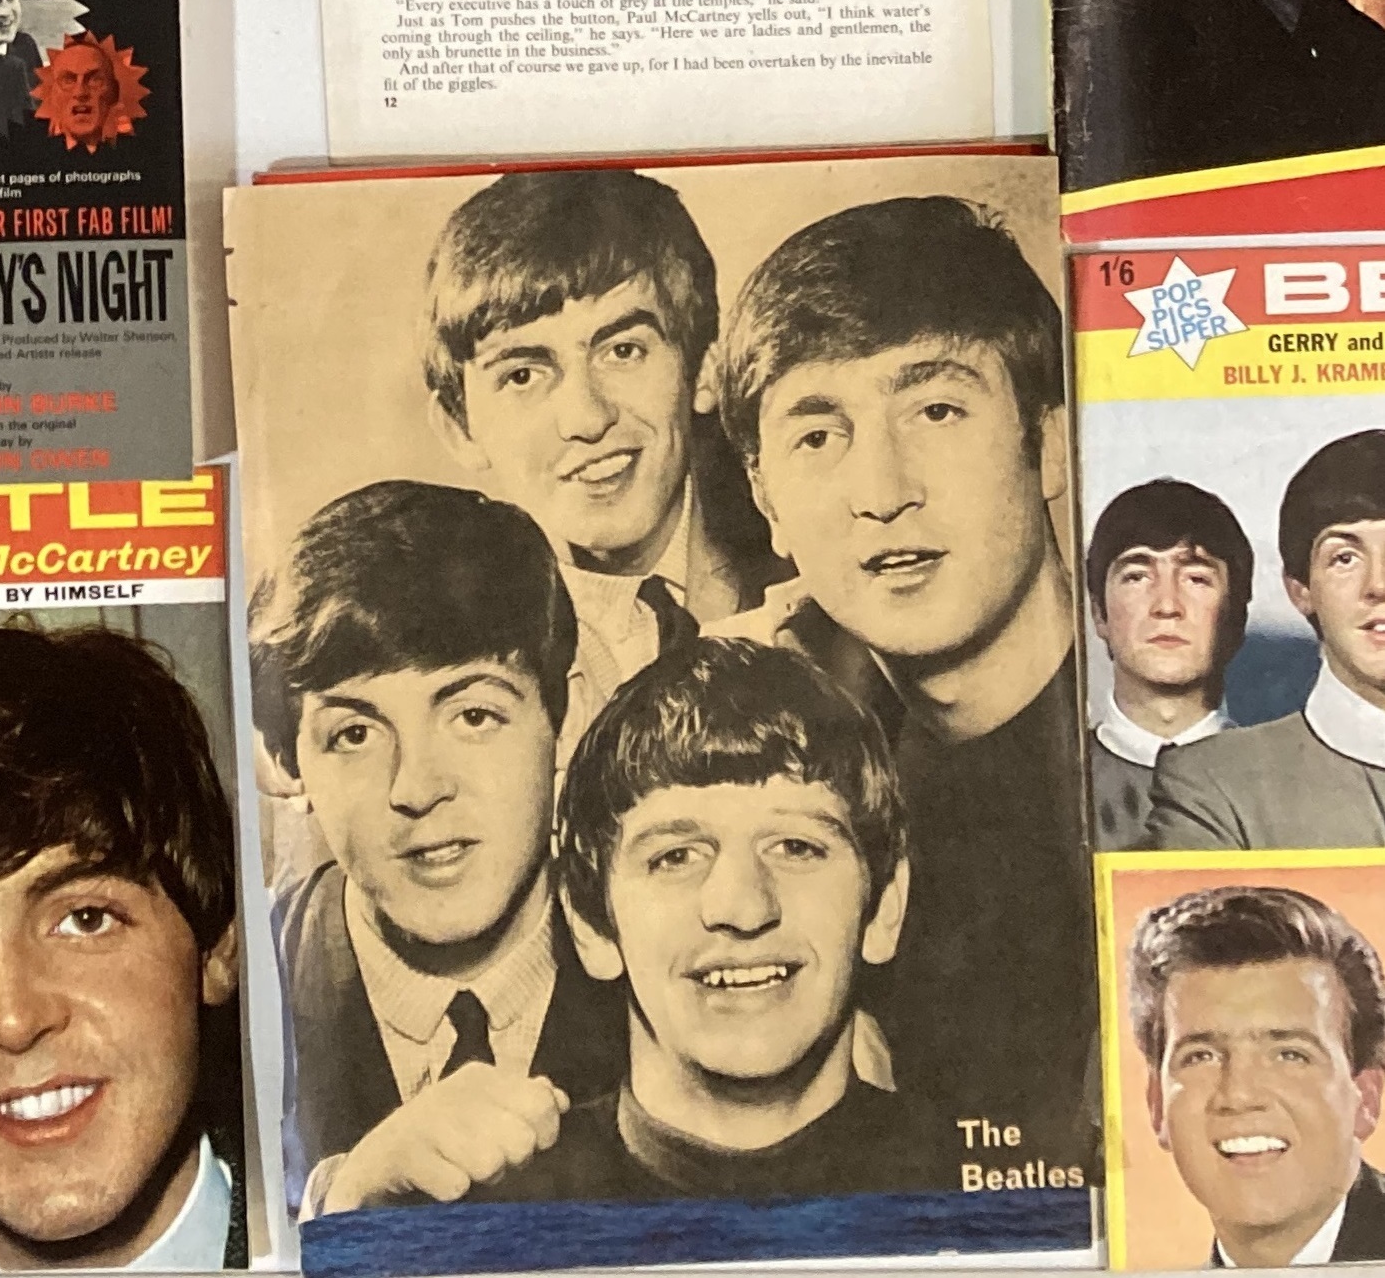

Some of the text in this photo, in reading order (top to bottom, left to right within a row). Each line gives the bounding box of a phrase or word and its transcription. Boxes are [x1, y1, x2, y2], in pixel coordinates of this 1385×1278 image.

[384, 78, 497, 93] fit of the giggles.
[10, 172, 45, 185] pages
[48, 171, 61, 182] of
[65, 170, 141, 184] photographs
[0, 187, 22, 198] film
[14, 208, 70, 237] FIRST
[77, 207, 114, 235] FAB
[120, 206, 173, 235] FILM!
[57, 249, 173, 323] NIGHT
[1268, 333, 1383, 352] GERRY and
[1224, 365, 1306, 384] BILLY J.
[5, 586, 32, 603] BY
[44, 584, 145, 601] HIMSELF
[957, 1118, 1021, 1149] The
[961, 1160, 1084, 1192] Beatles
